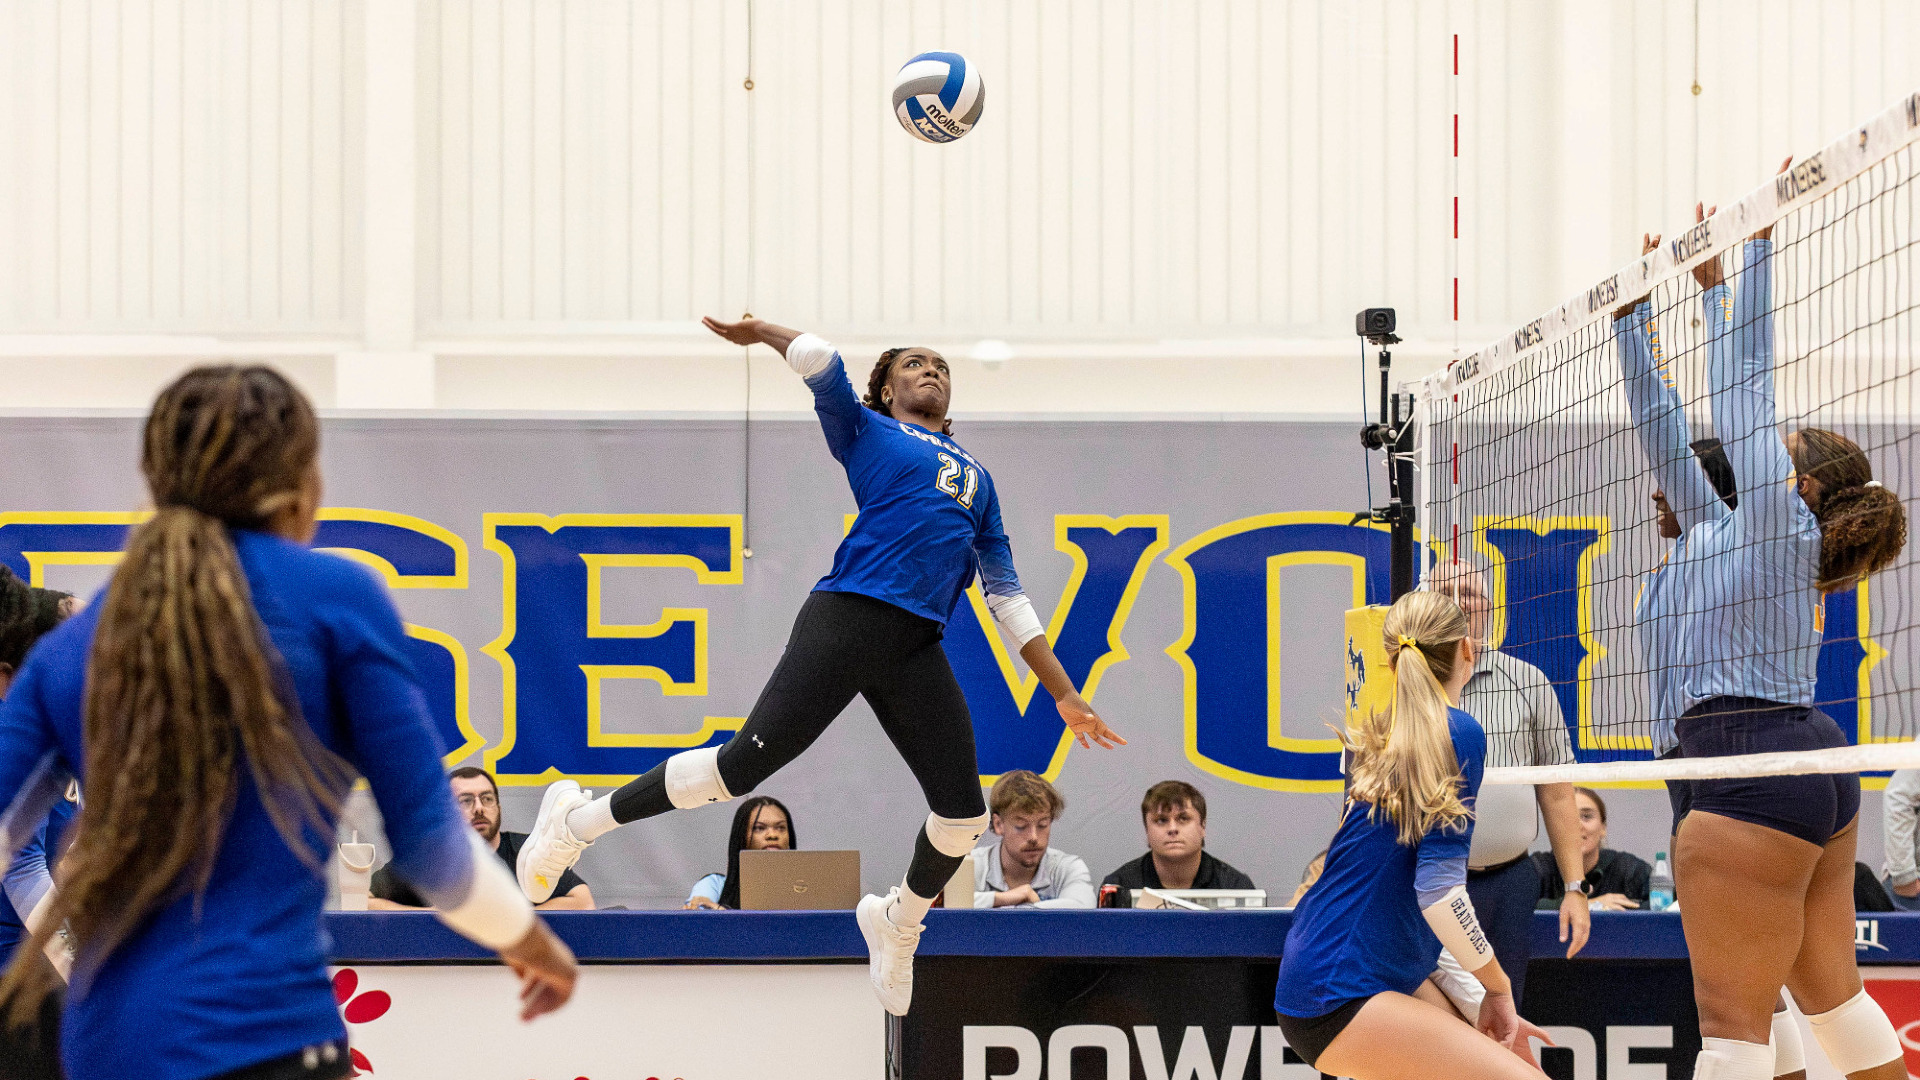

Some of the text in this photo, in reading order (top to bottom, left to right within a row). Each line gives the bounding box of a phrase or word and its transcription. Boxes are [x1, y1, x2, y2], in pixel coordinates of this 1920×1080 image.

[926, 104, 965, 136] molten
[936, 452, 978, 509] 21
[1450, 897, 1488, 955] GEAUX POKES
